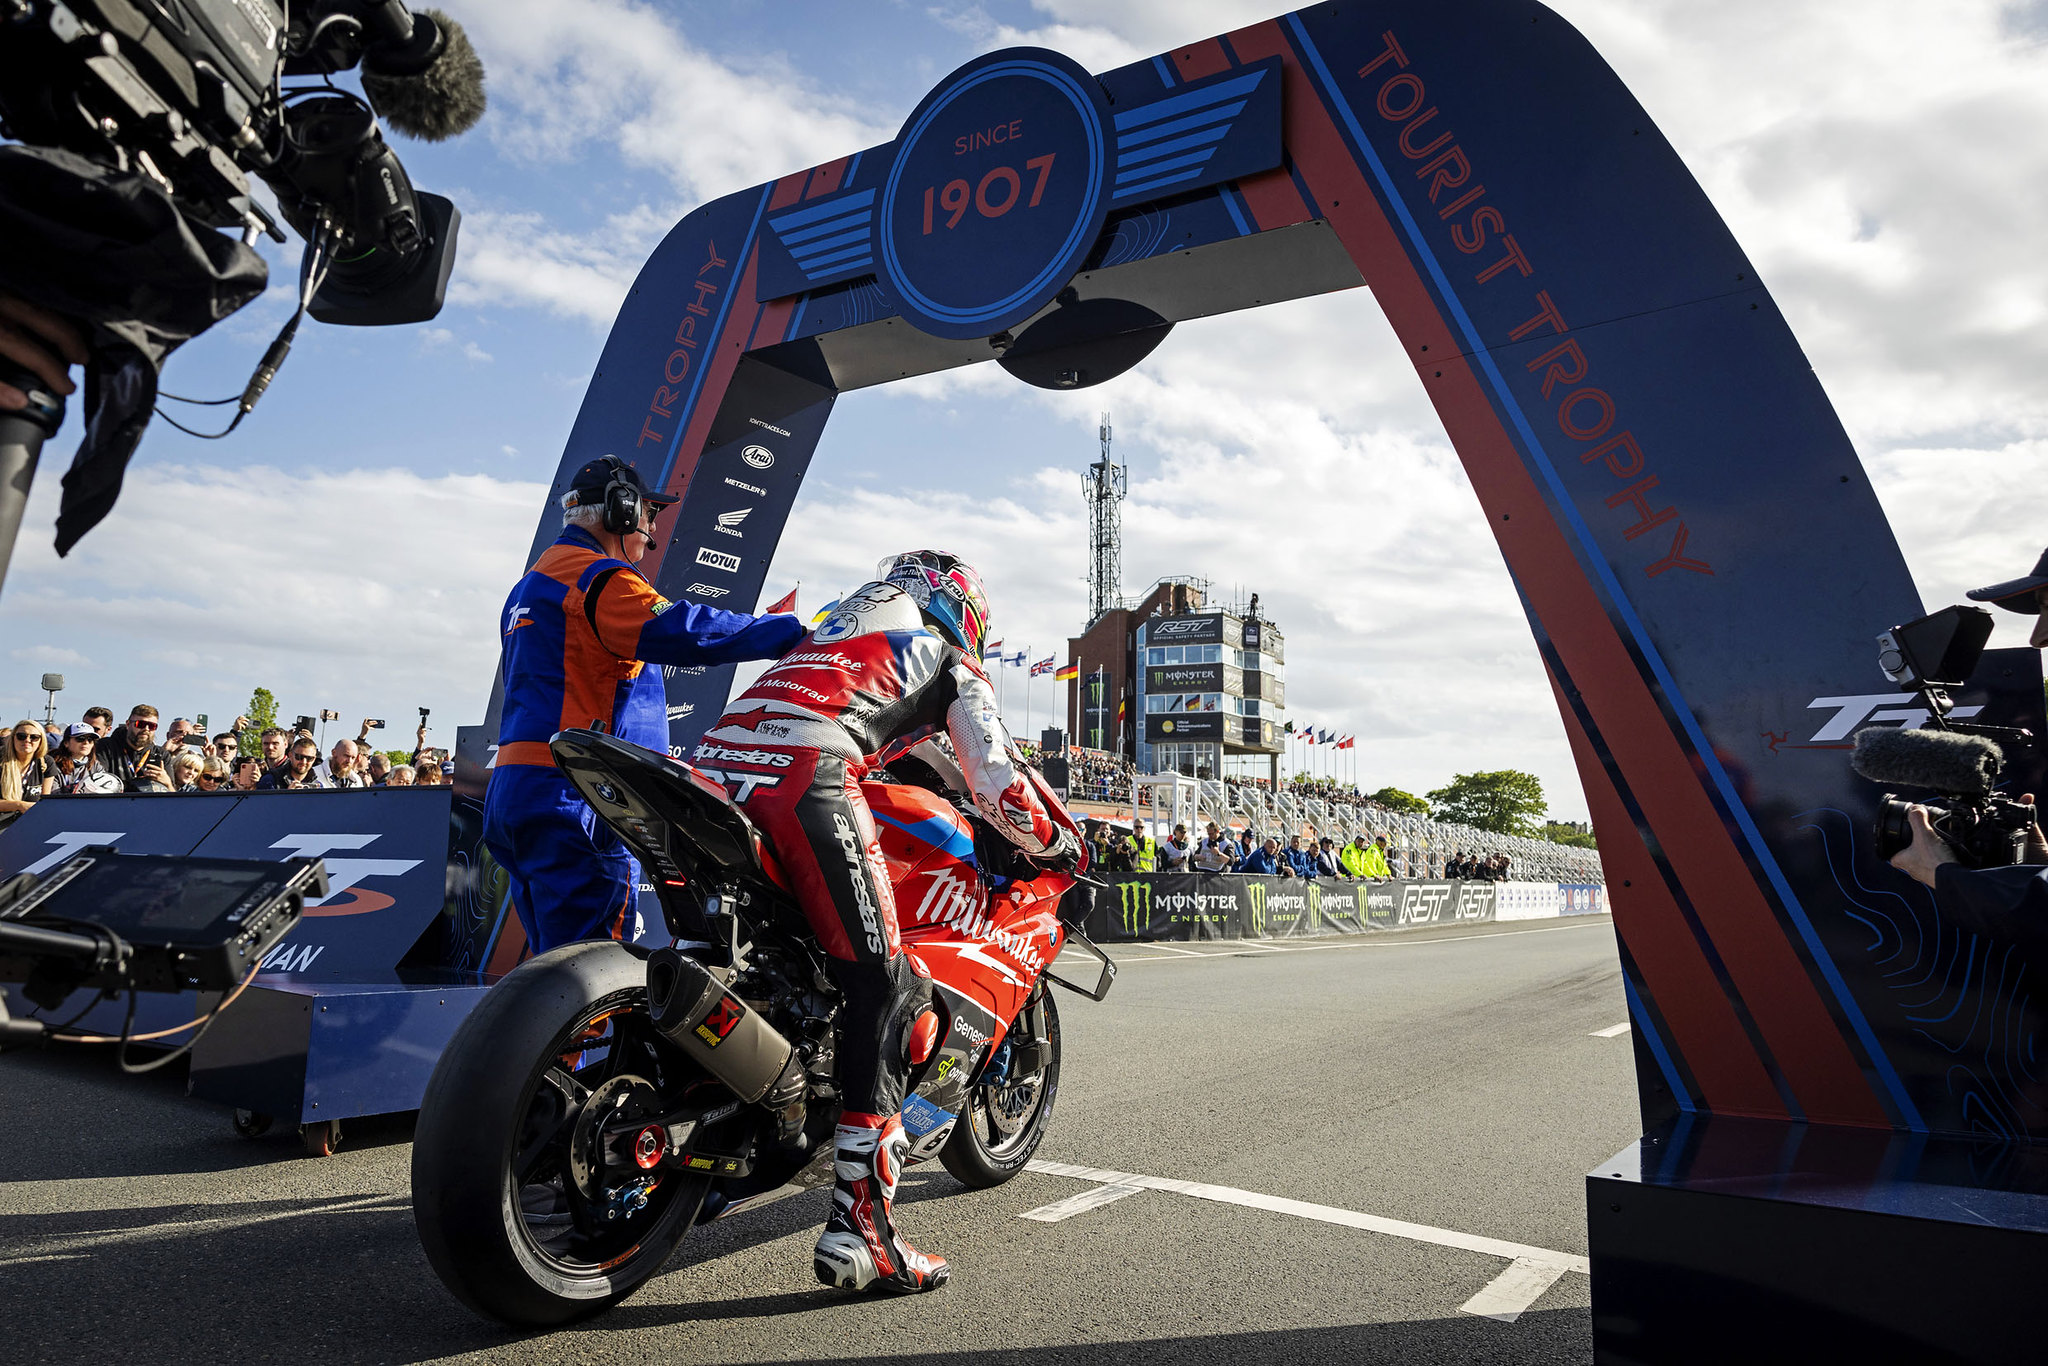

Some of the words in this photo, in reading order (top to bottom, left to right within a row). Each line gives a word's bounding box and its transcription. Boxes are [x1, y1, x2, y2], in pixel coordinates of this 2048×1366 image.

[954, 119, 1023, 155] SINCE
[922, 152, 1056, 236] 1907
[1358, 29, 1534, 285] TOURIST
[1508, 289, 1715, 578] TROPHY
[637, 239, 727, 448] TROPHY
[724, 477, 761, 494] METZELER
[714, 523, 743, 538] HONDA
[699, 550, 738, 571] MOTUL
[686, 582, 731, 598] RST
[941, 575, 965, 600] Arai
[1154, 619, 1216, 634] RST
[1165, 670, 1216, 681] MONSTER
[764, 679, 830, 703] Motorrad
[693, 742, 794, 767] alpinestars
[832, 812, 882, 955] alpinestars
[1155, 892, 1239, 912] MONSTER
[1266, 893, 1306, 911] MONSTER
[1321, 893, 1354, 910] MONSTER
[1367, 893, 1394, 909] MONSTER
[1398, 884, 1451, 924] RST
[1455, 885, 1495, 919] RST
[916, 867, 1045, 976] Milwaukee
